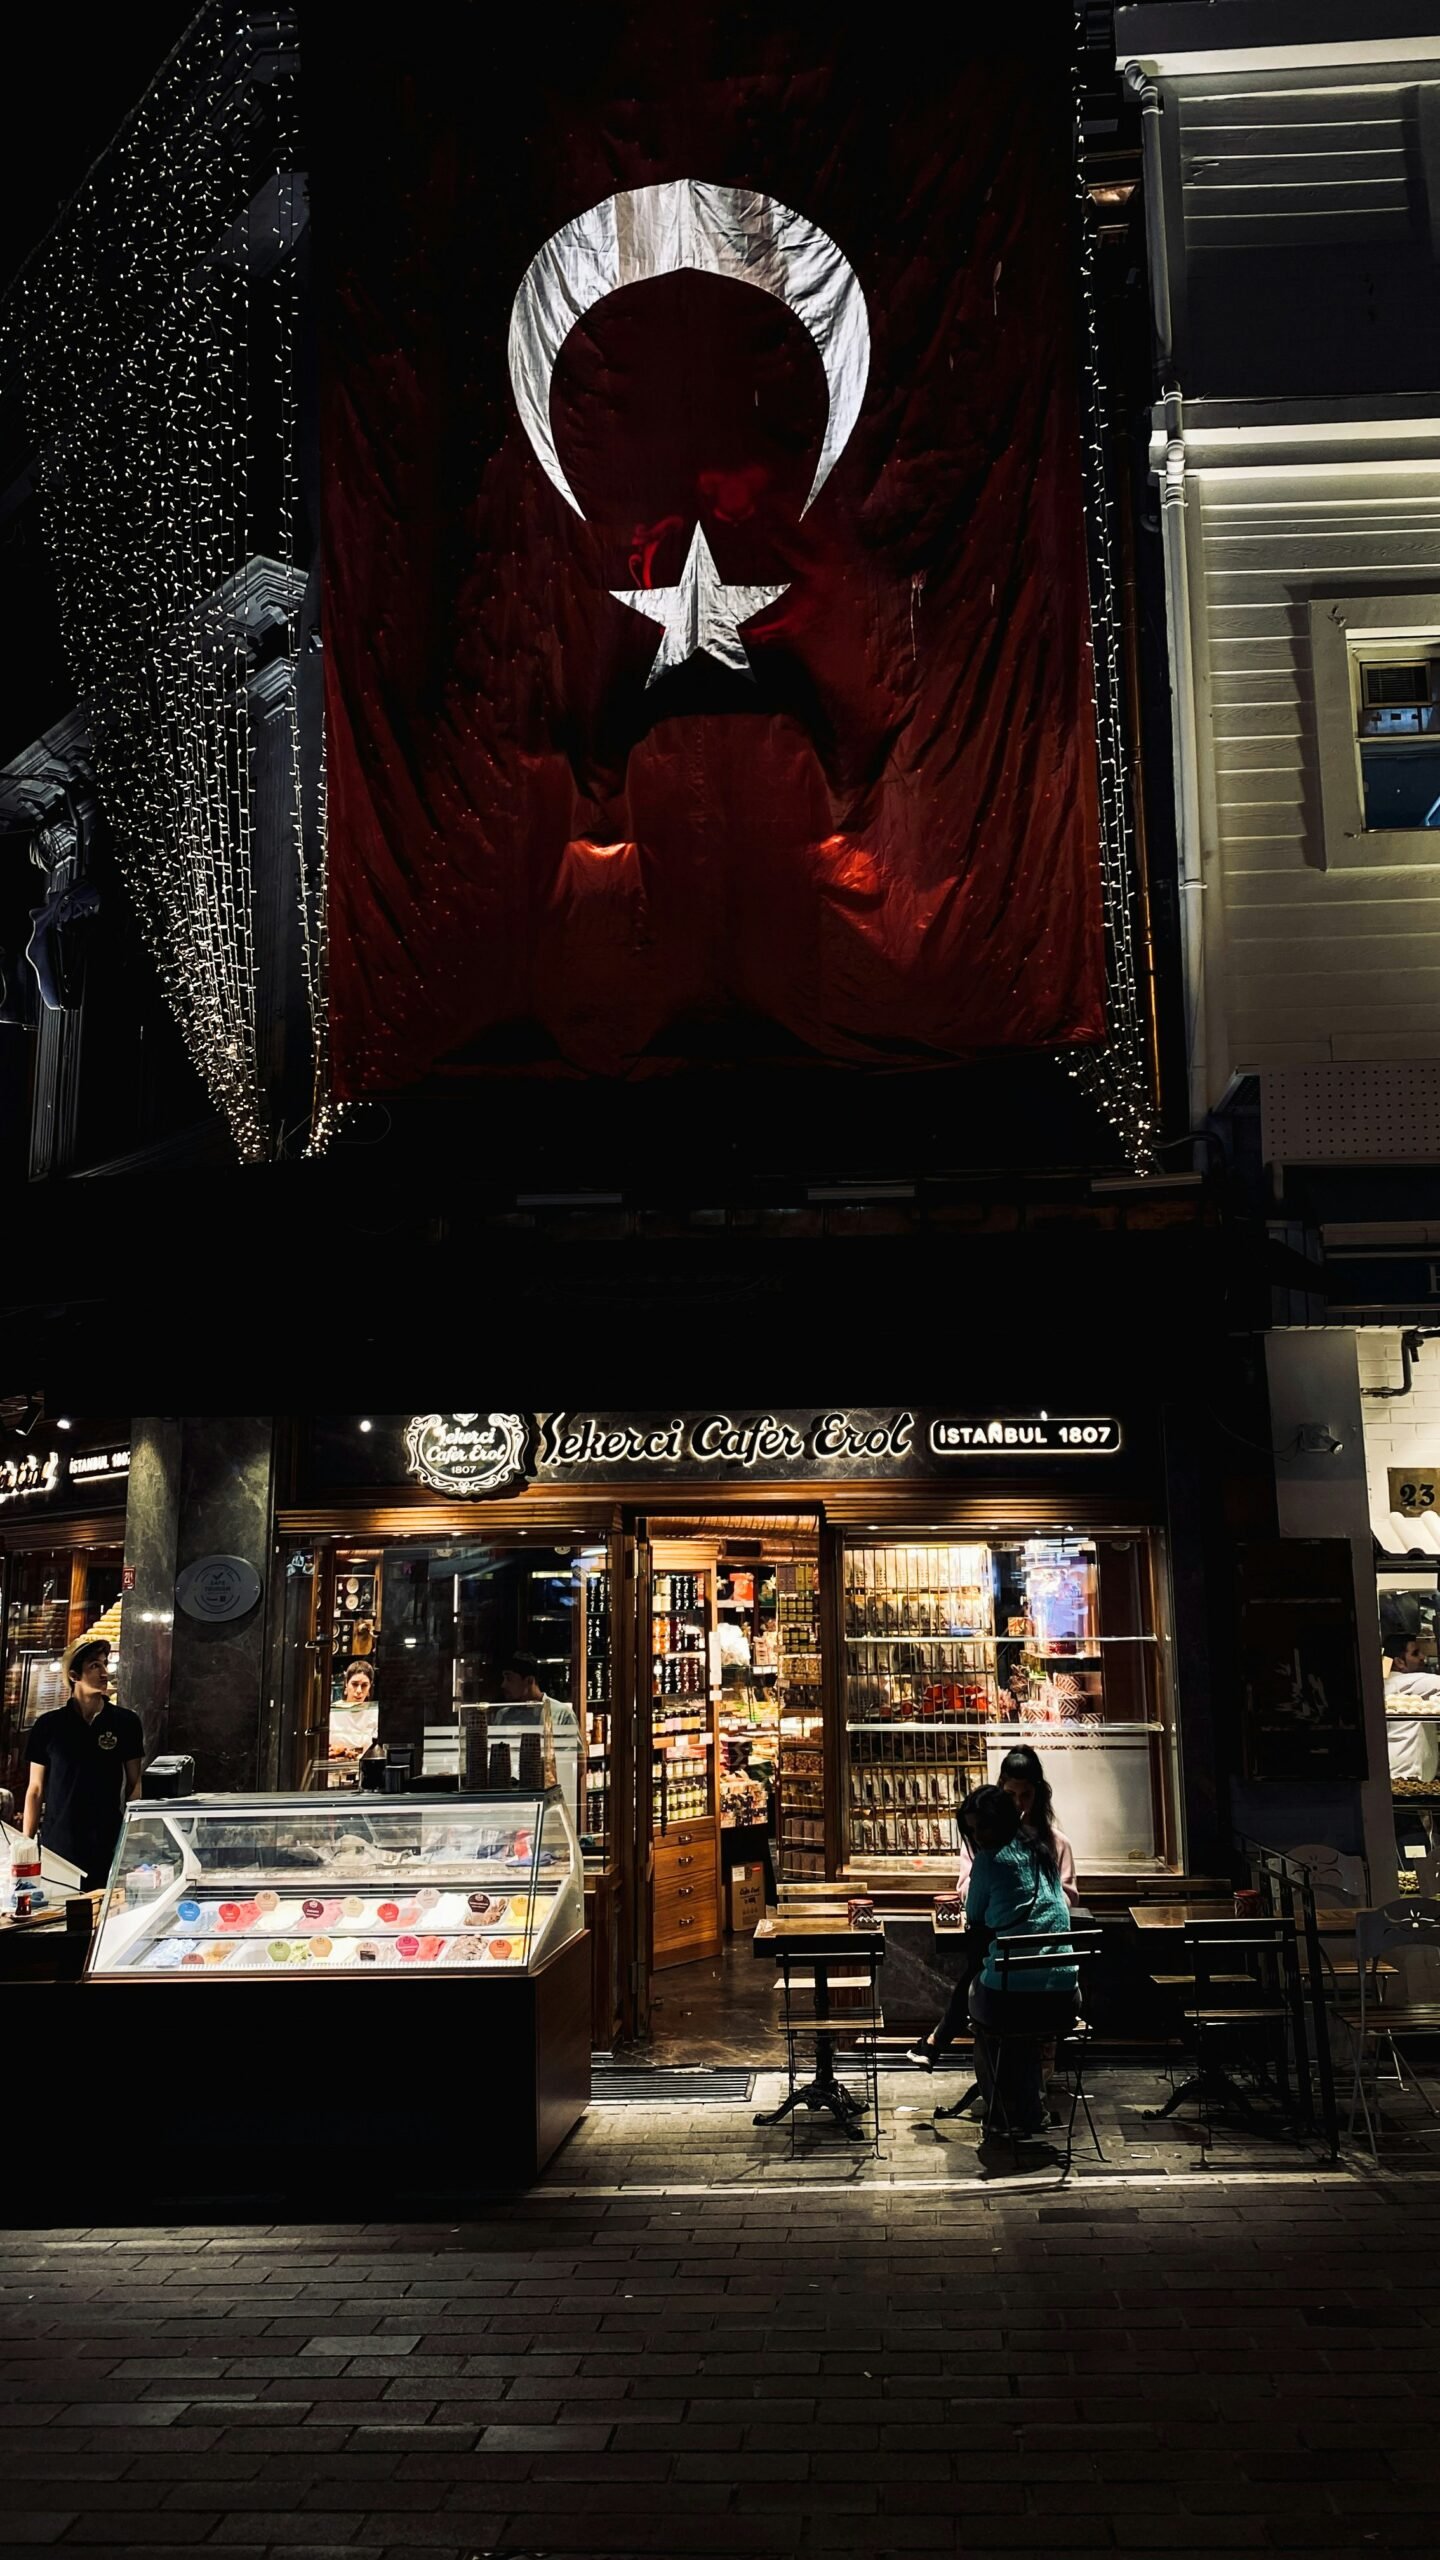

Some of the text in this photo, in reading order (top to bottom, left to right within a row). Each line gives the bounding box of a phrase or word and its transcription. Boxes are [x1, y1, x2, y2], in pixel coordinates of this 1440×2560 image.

[690, 1415, 804, 1468] Cafer
[813, 1412, 915, 1458] Erol
[1058, 1426, 1110, 1444] 1807
[426, 1444, 506, 1464] Cafer Erol
[451, 1466, 476, 1474] 1807
[1400, 1484, 1435, 1506] 23
